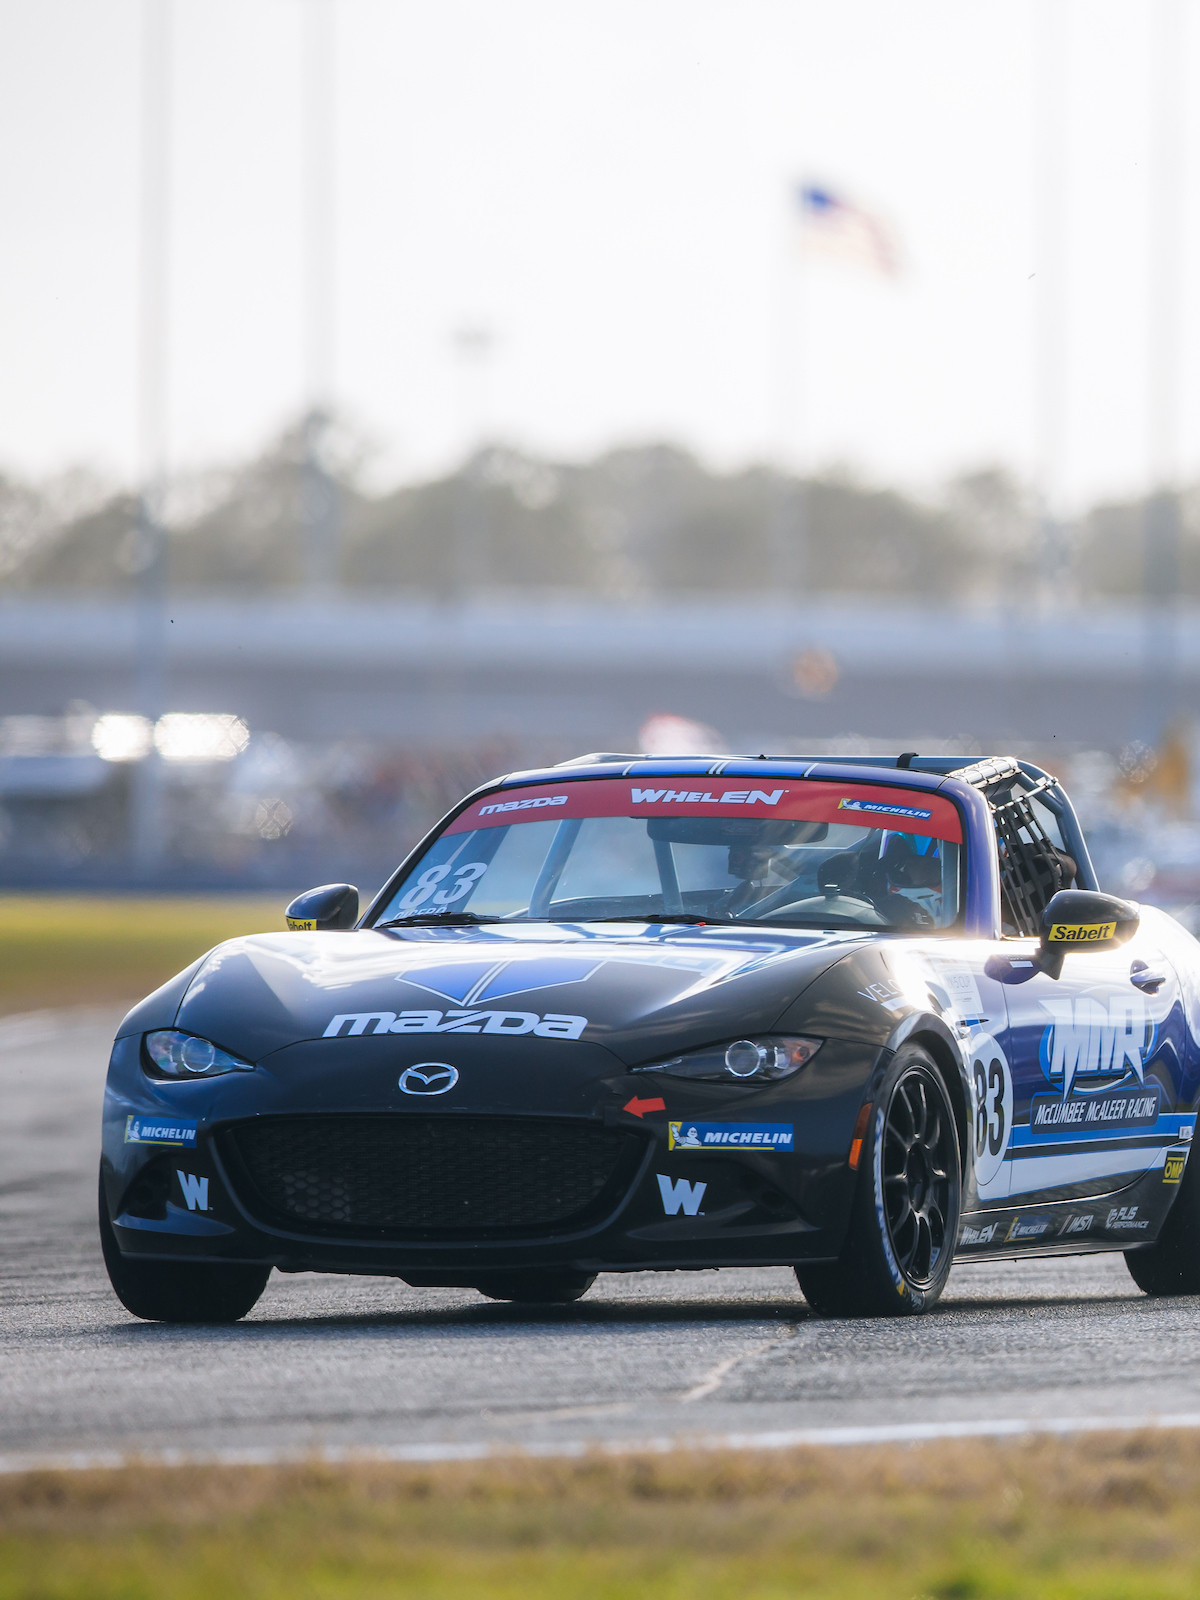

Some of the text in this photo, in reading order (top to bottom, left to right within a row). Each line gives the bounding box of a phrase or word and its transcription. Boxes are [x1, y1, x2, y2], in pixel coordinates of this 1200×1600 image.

[630, 788, 785, 806] WHELEN
[863, 803, 932, 820] MICHELIN
[398, 862, 488, 910] 83
[1053, 925, 1111, 940] Sabelt
[973, 1057, 1005, 1158] 83
[1125, 1096, 1158, 1119] RACING
[141, 1126, 197, 1140] MICHELIN
[704, 1132, 793, 1144] MICHELIN
[1164, 1161, 1184, 1179] OMP
[176, 1169, 209, 1211] W
[656, 1174, 708, 1216] W
